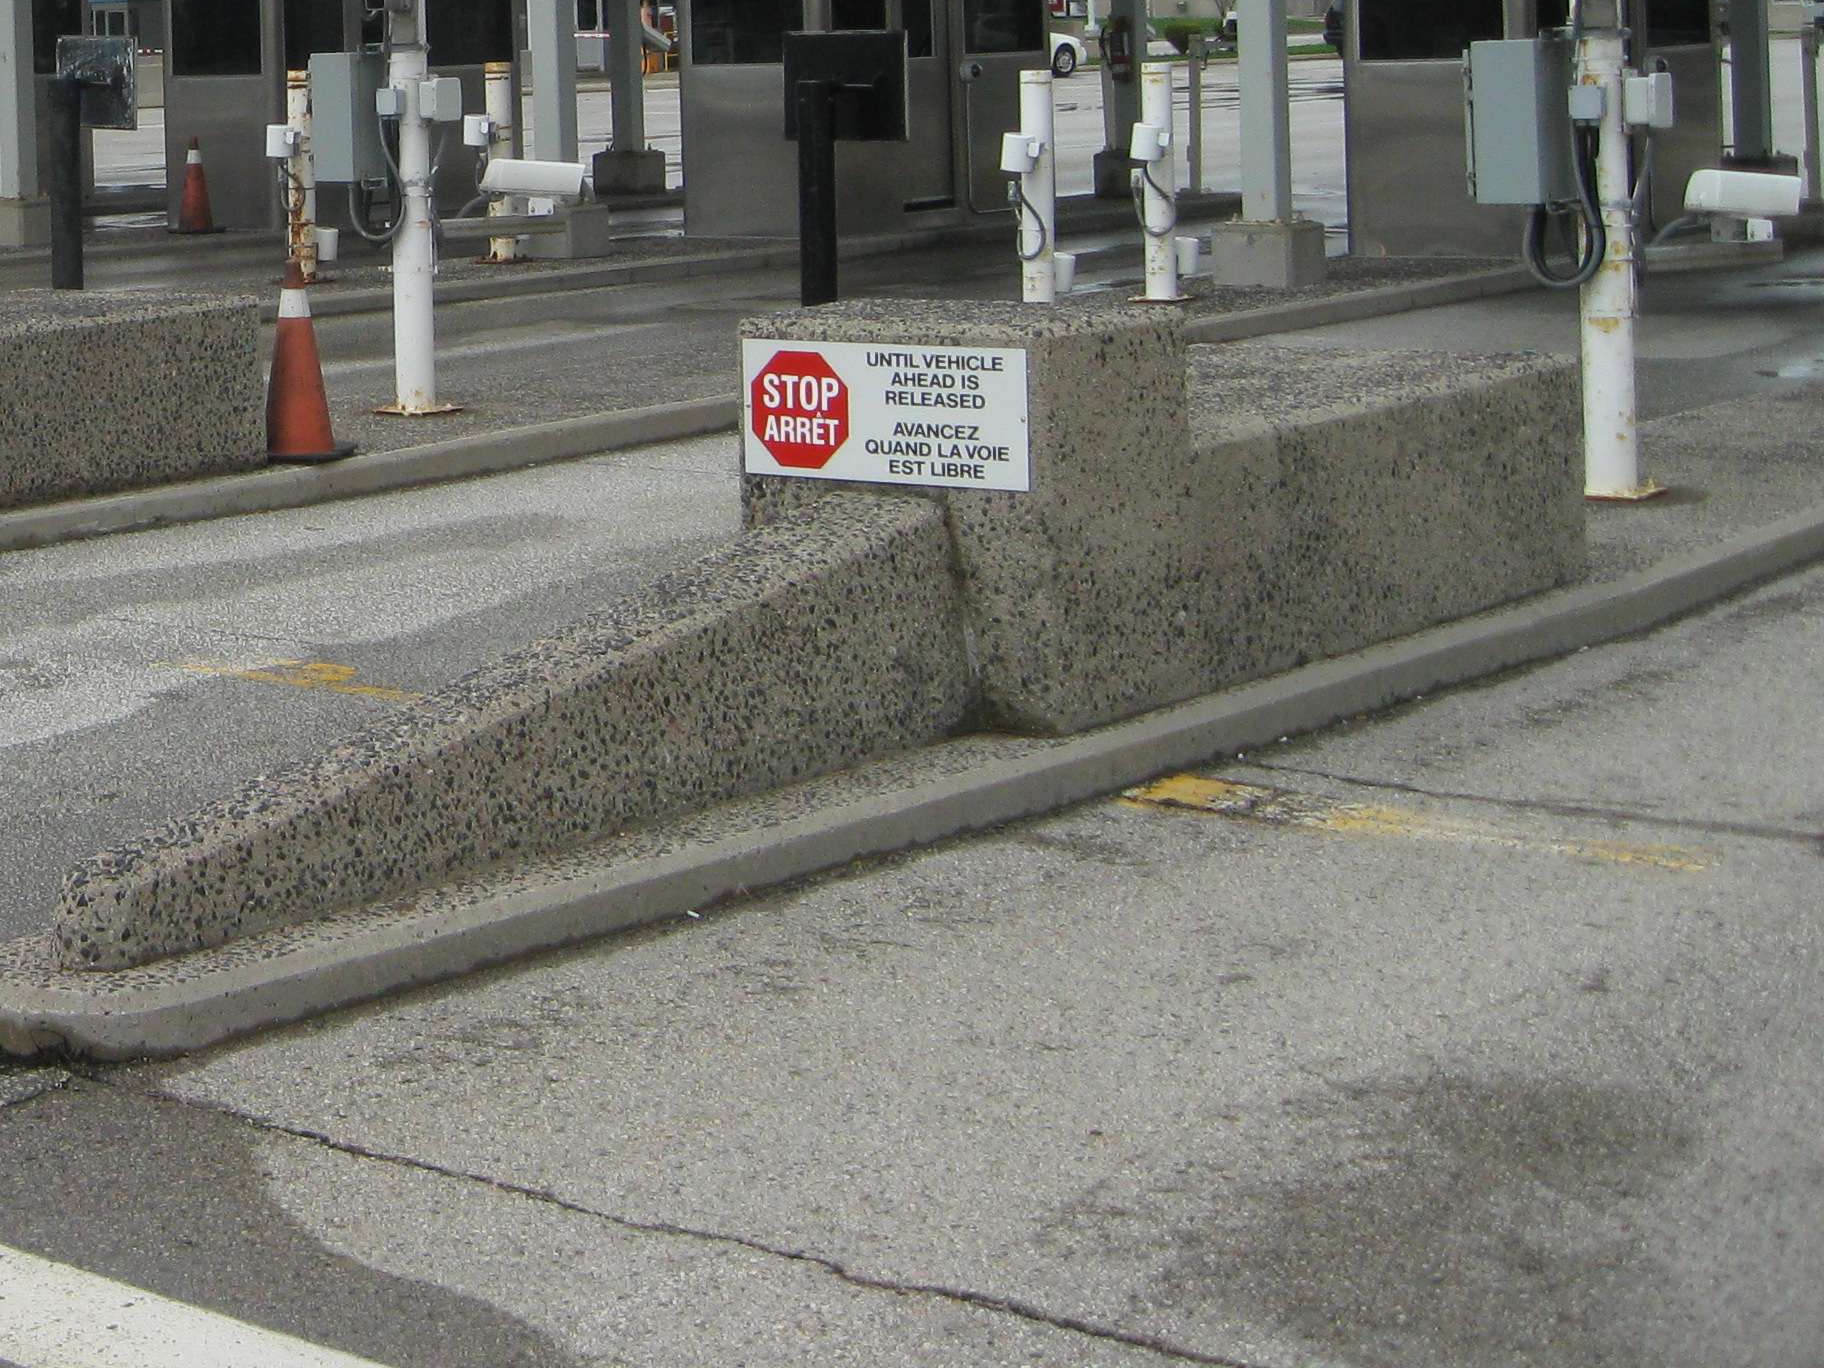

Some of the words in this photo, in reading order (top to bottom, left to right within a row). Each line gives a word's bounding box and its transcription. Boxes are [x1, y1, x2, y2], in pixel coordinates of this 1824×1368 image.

[866, 352, 922, 369] UNTIL
[923, 355, 1004, 372] VEHICLE
[891, 372, 955, 389] AHEAD
[961, 375, 980, 390] IS
[763, 373, 840, 411] STOP
[885, 391, 986, 410] RELEASED
[764, 411, 840, 446] ARRÊT
[893, 422, 980, 441] AVANCEZ
[865, 439, 932, 457] QUAND
[938, 443, 963, 459] LA
[965, 445, 1010, 461] VOIE
[889, 460, 925, 476] EST
[931, 461, 986, 480] LIBRE
